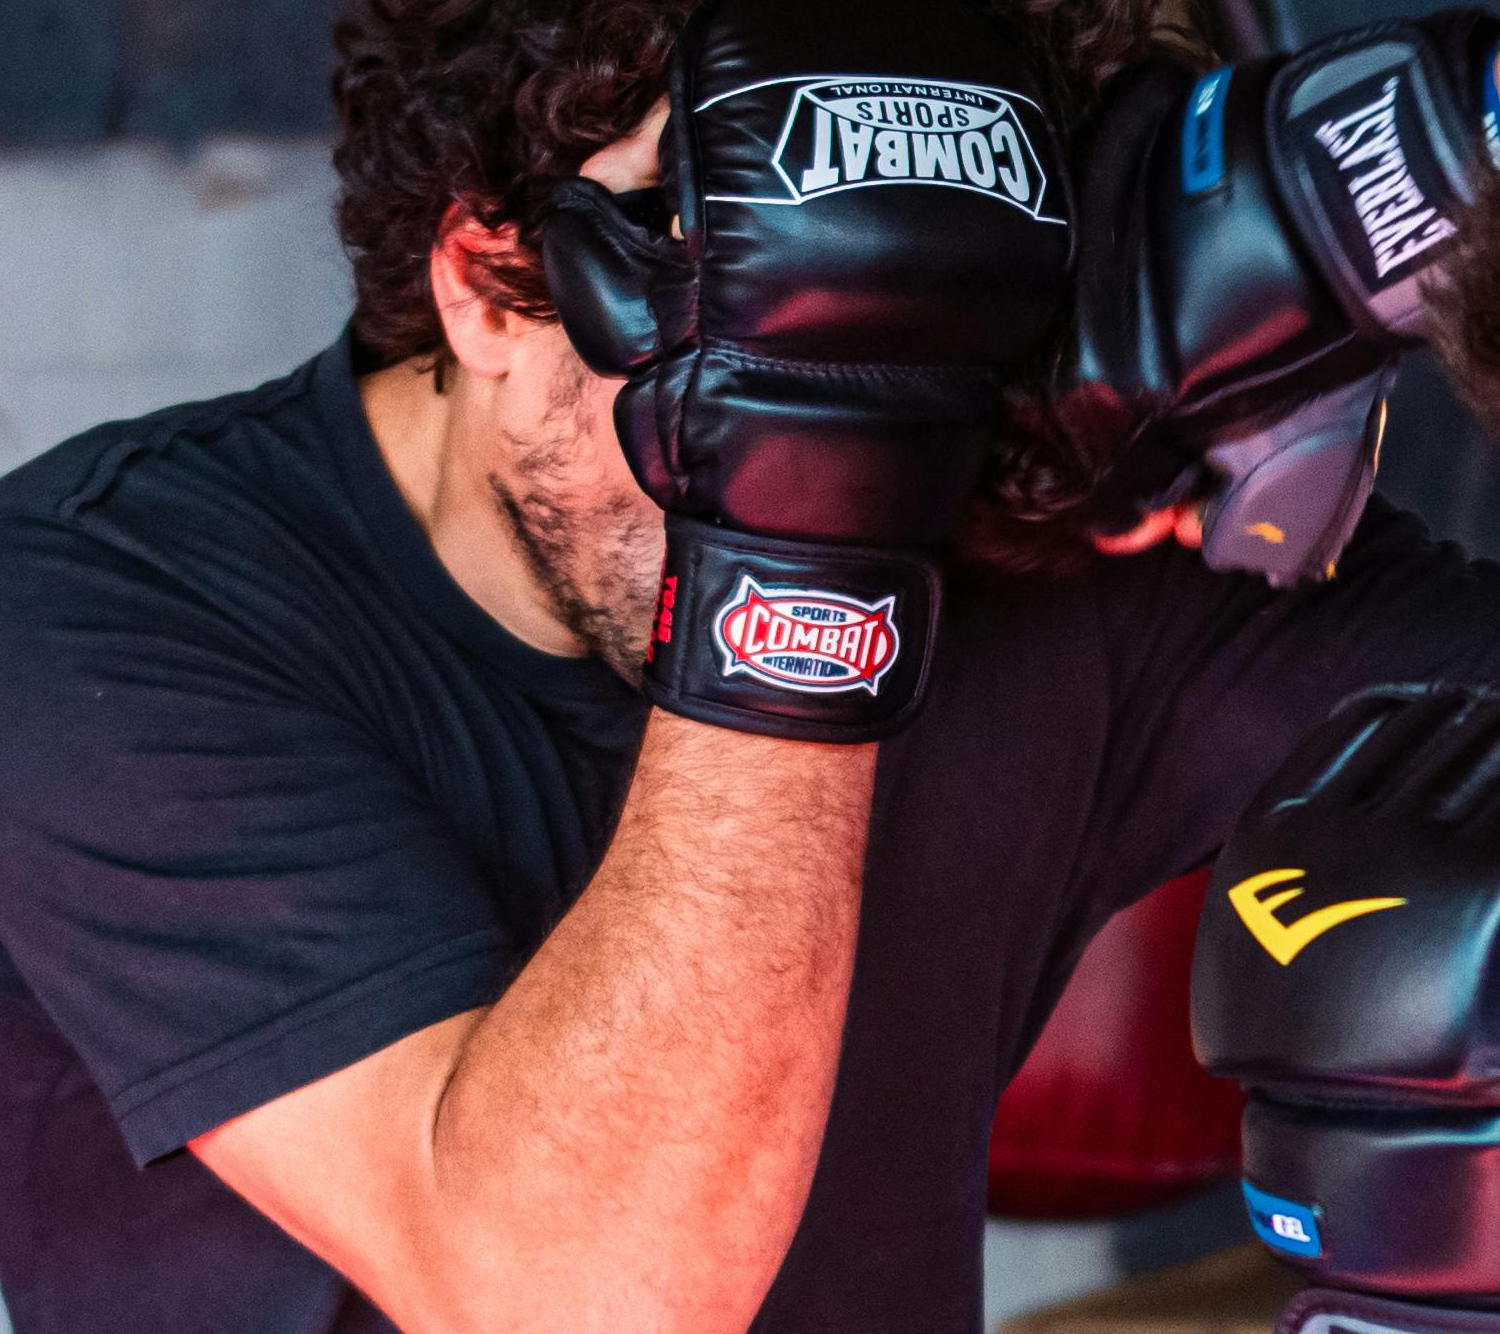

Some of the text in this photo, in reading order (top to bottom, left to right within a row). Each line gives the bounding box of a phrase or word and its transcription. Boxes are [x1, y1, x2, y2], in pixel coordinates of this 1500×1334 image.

[830, 83, 984, 106] INTERNATIONAL
[856, 100, 970, 127] SPORTS
[800, 106, 1030, 203] COMBAT
[1314, 87, 1457, 279] EVERLAST
[744, 604, 879, 669] COMBAT
[791, 605, 847, 623] SPORTS
